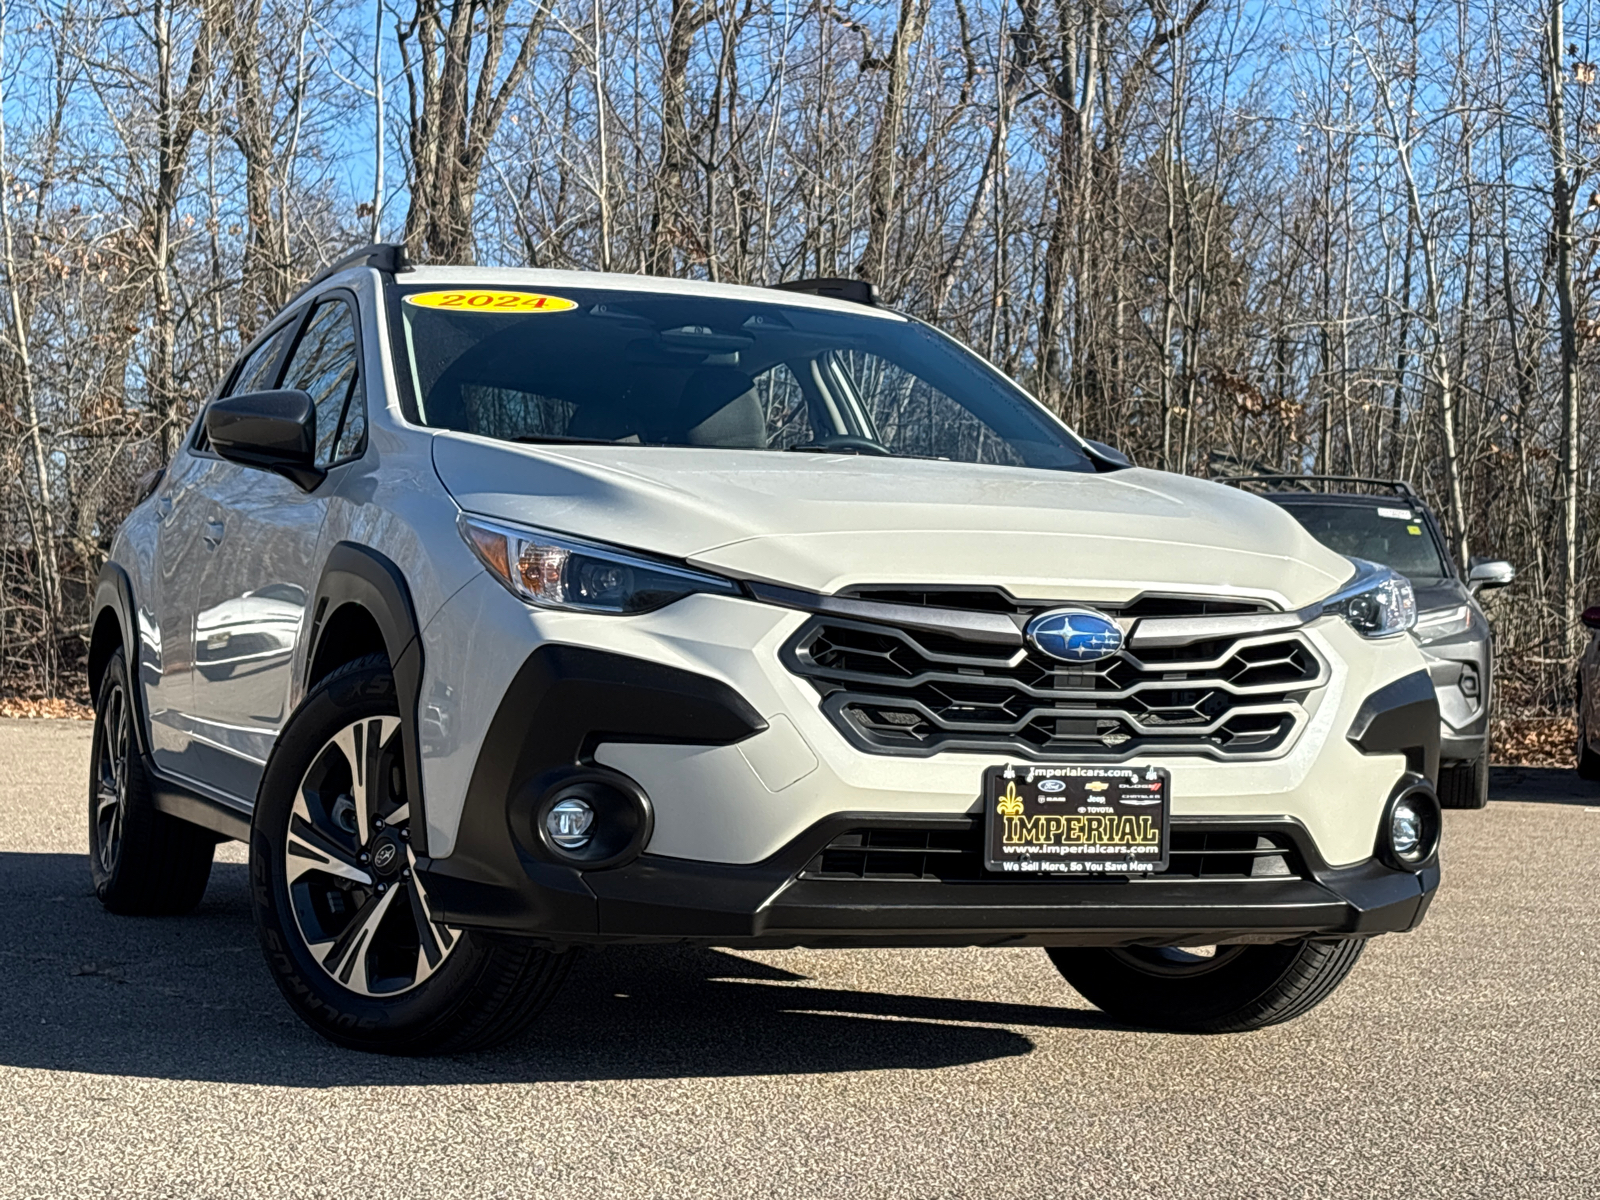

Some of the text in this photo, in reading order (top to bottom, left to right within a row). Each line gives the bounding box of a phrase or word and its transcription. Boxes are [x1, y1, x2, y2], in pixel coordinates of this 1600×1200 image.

[438, 294, 549, 309] 2024
[1042, 781, 1062, 791] Ford
[1087, 795, 1106, 804] Jeep
[1003, 815, 1159, 844] IMPERIAL
[1003, 844, 1159, 855] www.imperialcars.com
[1003, 861, 1153, 873] We Sell More, So You Save More
